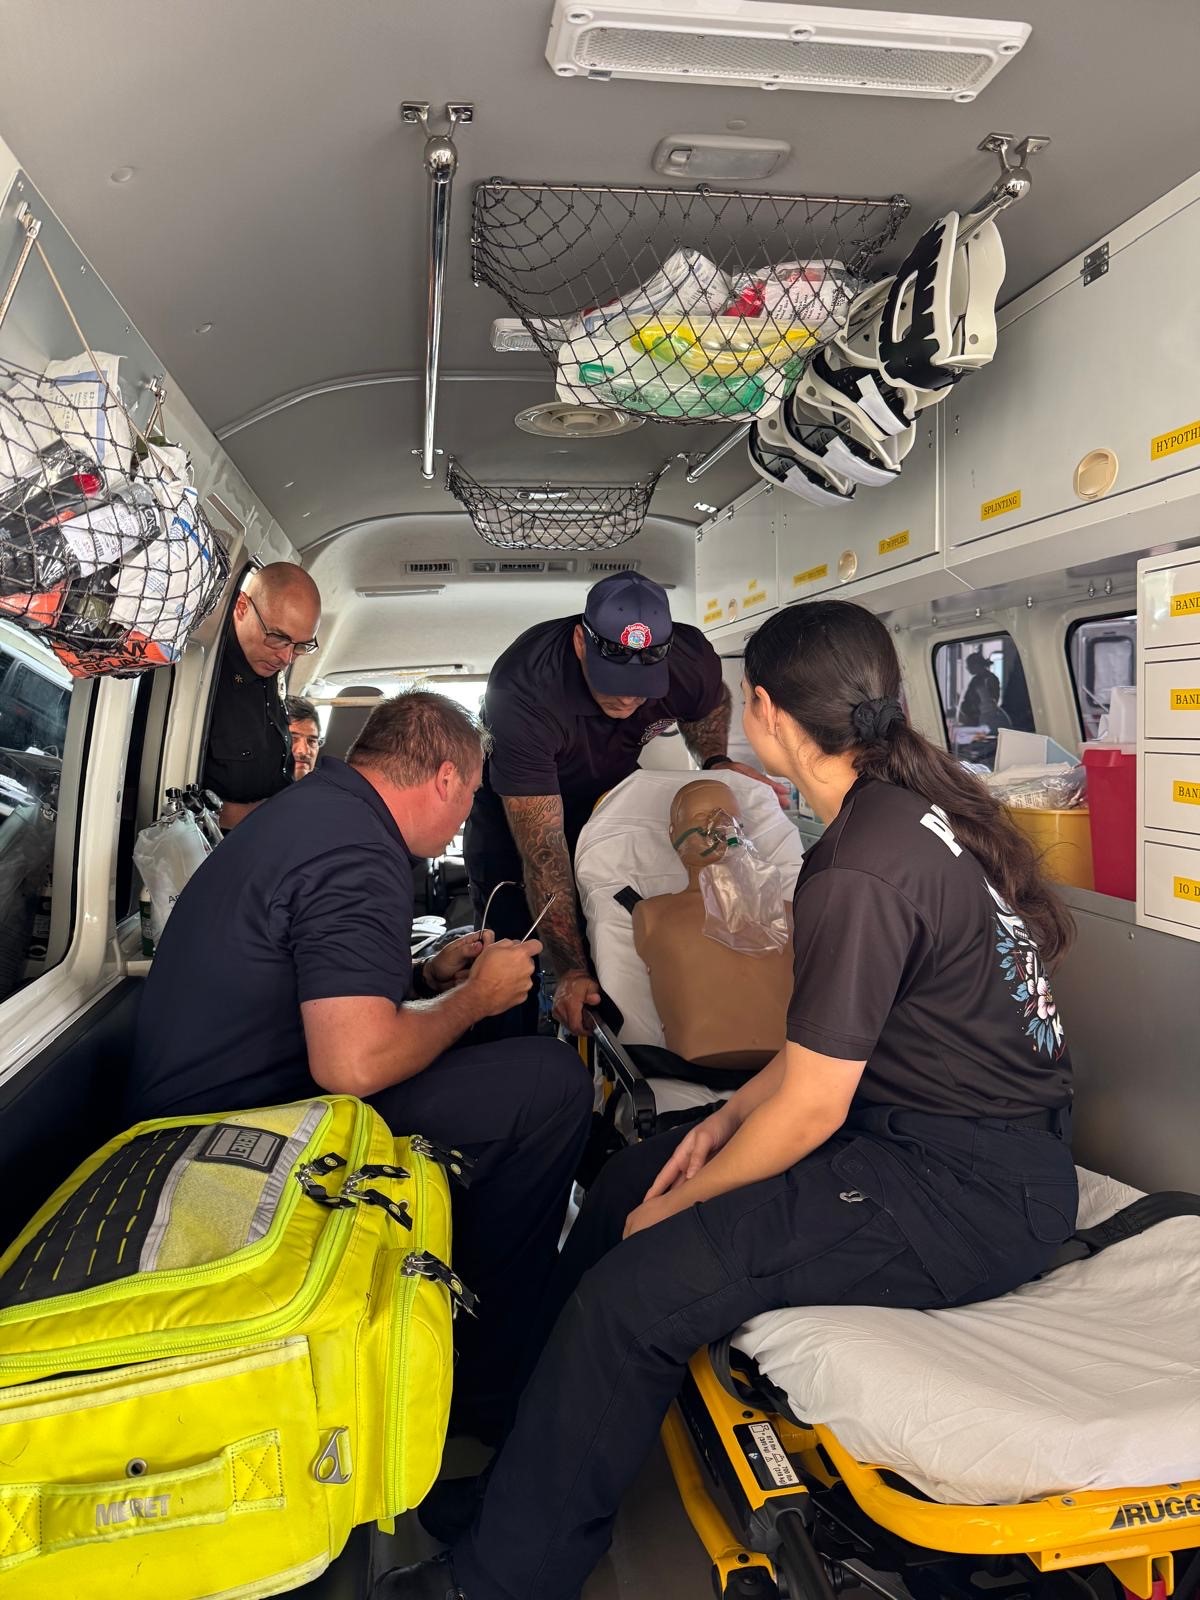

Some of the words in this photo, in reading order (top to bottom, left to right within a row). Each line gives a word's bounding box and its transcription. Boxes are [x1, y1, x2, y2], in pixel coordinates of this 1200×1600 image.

[983, 495, 1017, 516] SPLINTING
[1179, 883, 1190, 894] IO
[229, 1129, 261, 1159] MERET
[96, 1494, 171, 1527] MERET
